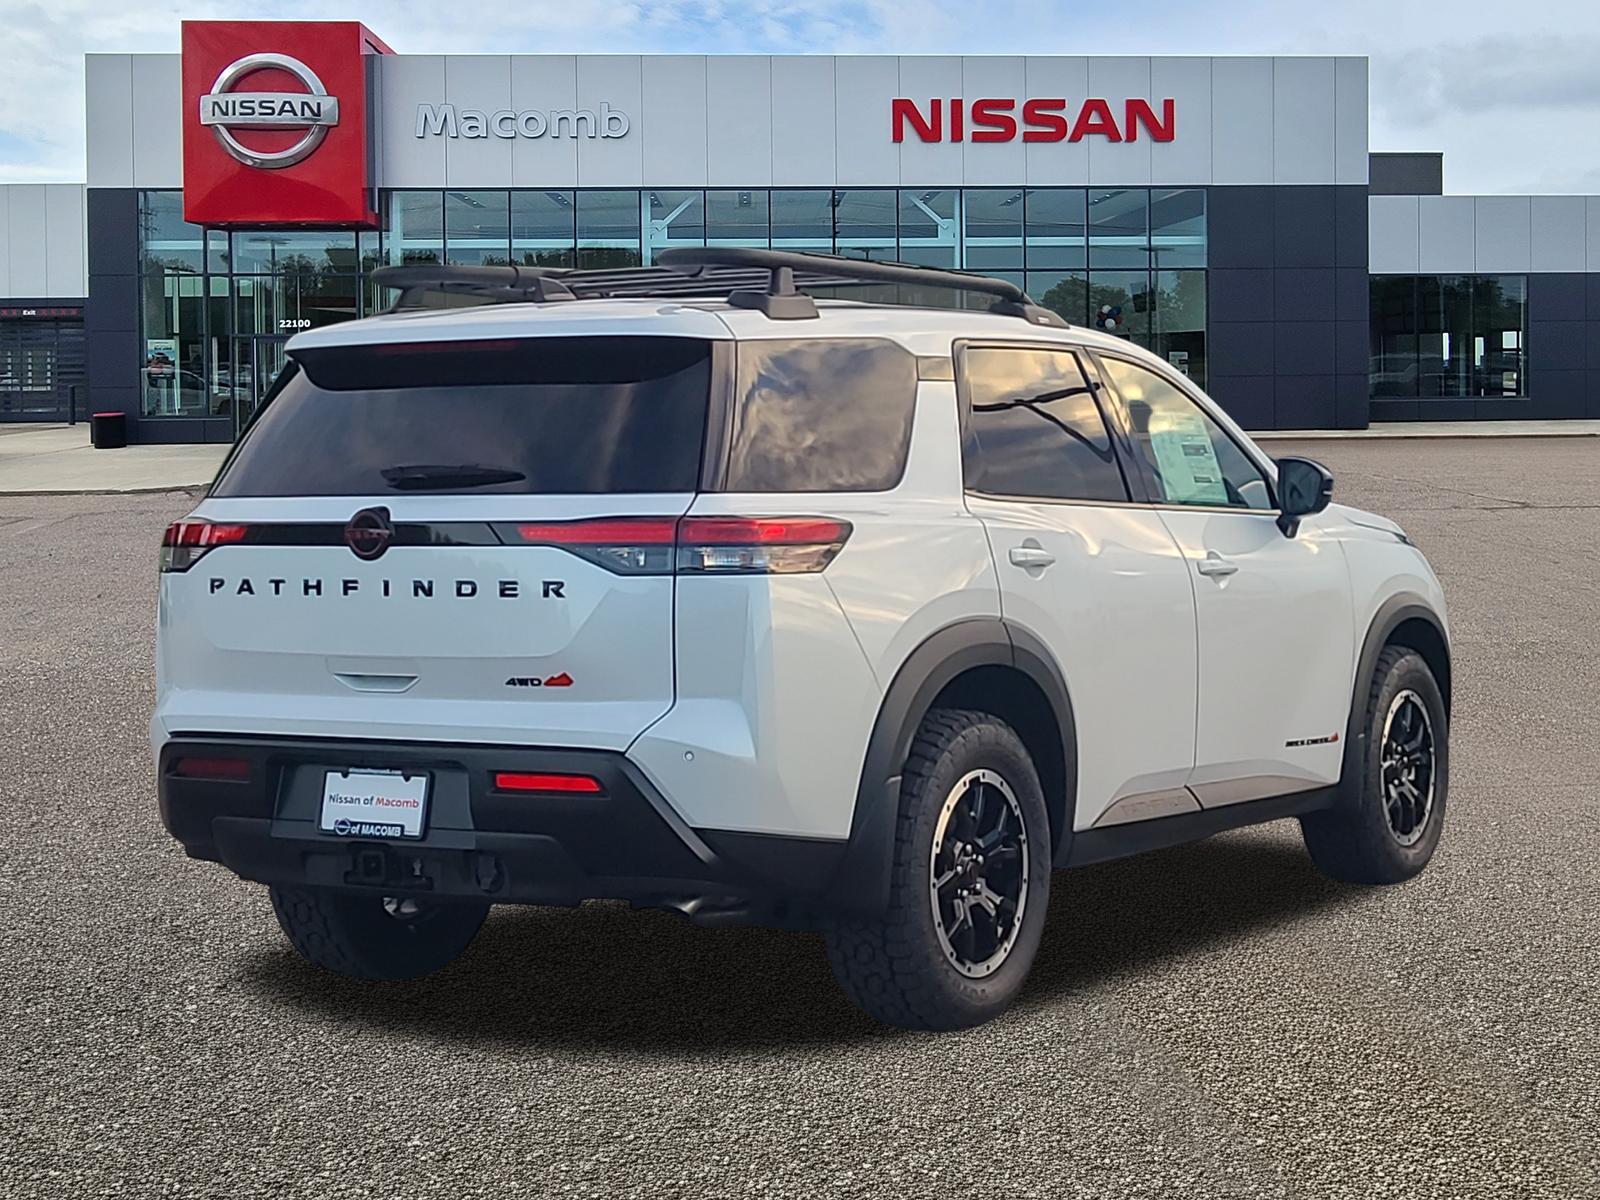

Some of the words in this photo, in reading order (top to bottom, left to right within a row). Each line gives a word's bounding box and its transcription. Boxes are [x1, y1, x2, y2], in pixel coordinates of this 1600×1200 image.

[212, 100, 321, 117] NISSAN
[415, 102, 630, 138] Macomb
[892, 98, 1175, 142] NISSAN
[279, 319, 310, 328] 22100
[209, 577, 566, 599] PATHFINDER
[505, 677, 542, 687] 4WD
[329, 793, 360, 805] Nissan
[363, 796, 374, 806] of
[375, 797, 419, 808] Macomb
[361, 824, 401, 836] MACOMB
